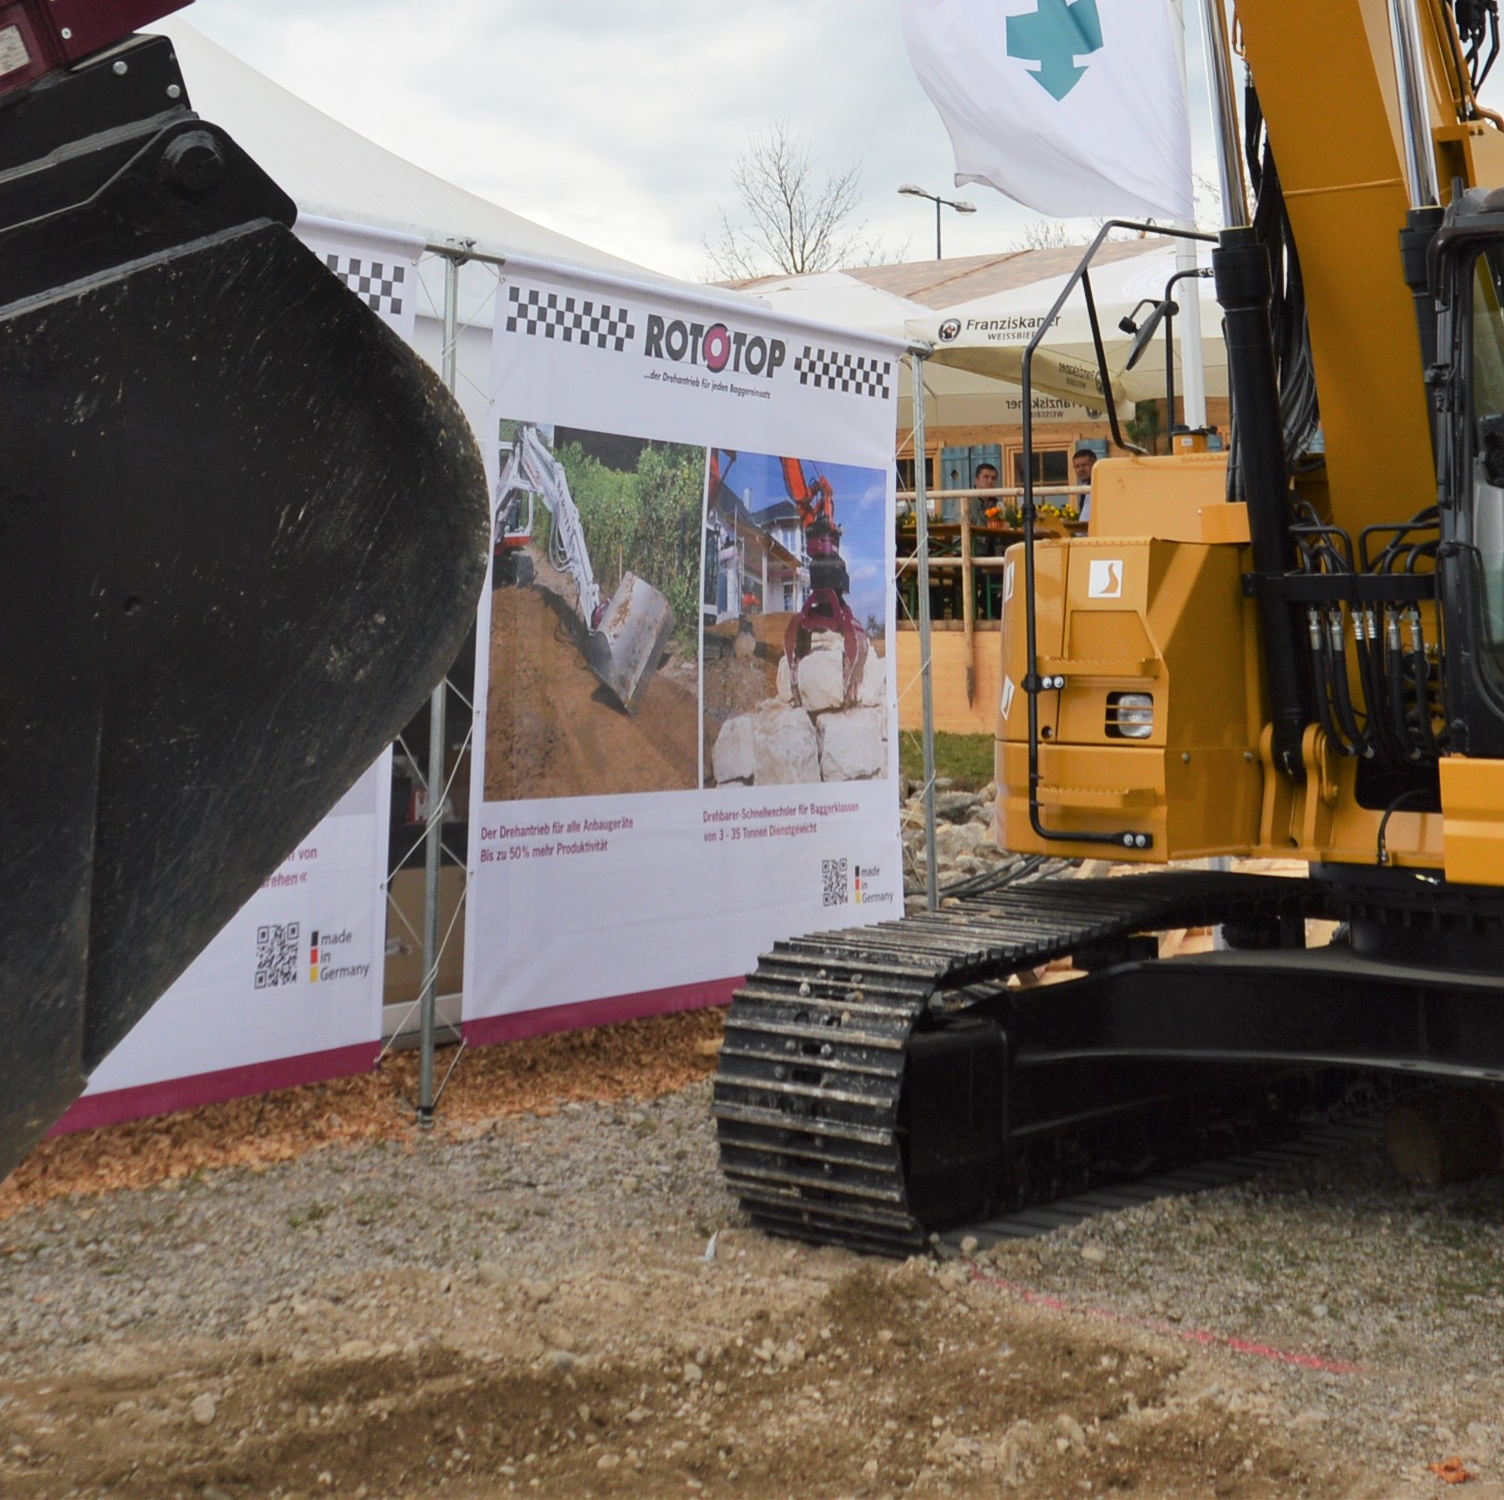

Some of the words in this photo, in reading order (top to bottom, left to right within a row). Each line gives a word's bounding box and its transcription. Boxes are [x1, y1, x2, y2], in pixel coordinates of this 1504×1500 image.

[644, 313, 786, 378] ROTOTOP
[662, 372, 700, 387] Drehantrieb
[701, 377, 711, 389] für
[711, 380, 728, 393] jeden
[729, 383, 771, 399] Baggereinsatz
[702, 805, 797, 823] Drehbarer-Schnellwechsler
[798, 804, 809, 815] für
[810, 802, 860, 817] Baggerklassen
[481, 826, 496, 841] Der
[499, 823, 550, 839] Drehantrieb
[552, 821, 564, 834] für
[566, 820, 581, 833] alle
[583, 816, 634, 832] Anbaugeräte
[703, 831, 717, 842] von
[718, 829, 724, 841] 3
[731, 828, 741, 840] 35
[743, 827, 768, 839] Tonnen
[769, 822, 817, 838] Dienstgewicht
[298, 848, 317, 860] von
[480, 848, 494, 862] Bis
[496, 851, 507, 861] zu
[532, 844, 554, 858] mehr
[556, 839, 608, 855] Produktivität
[861, 866, 880, 877] made
[861, 892, 894, 904] Germany
[320, 929, 352, 946] made
[320, 951, 331, 963] in
[320, 963, 371, 982] Germany
